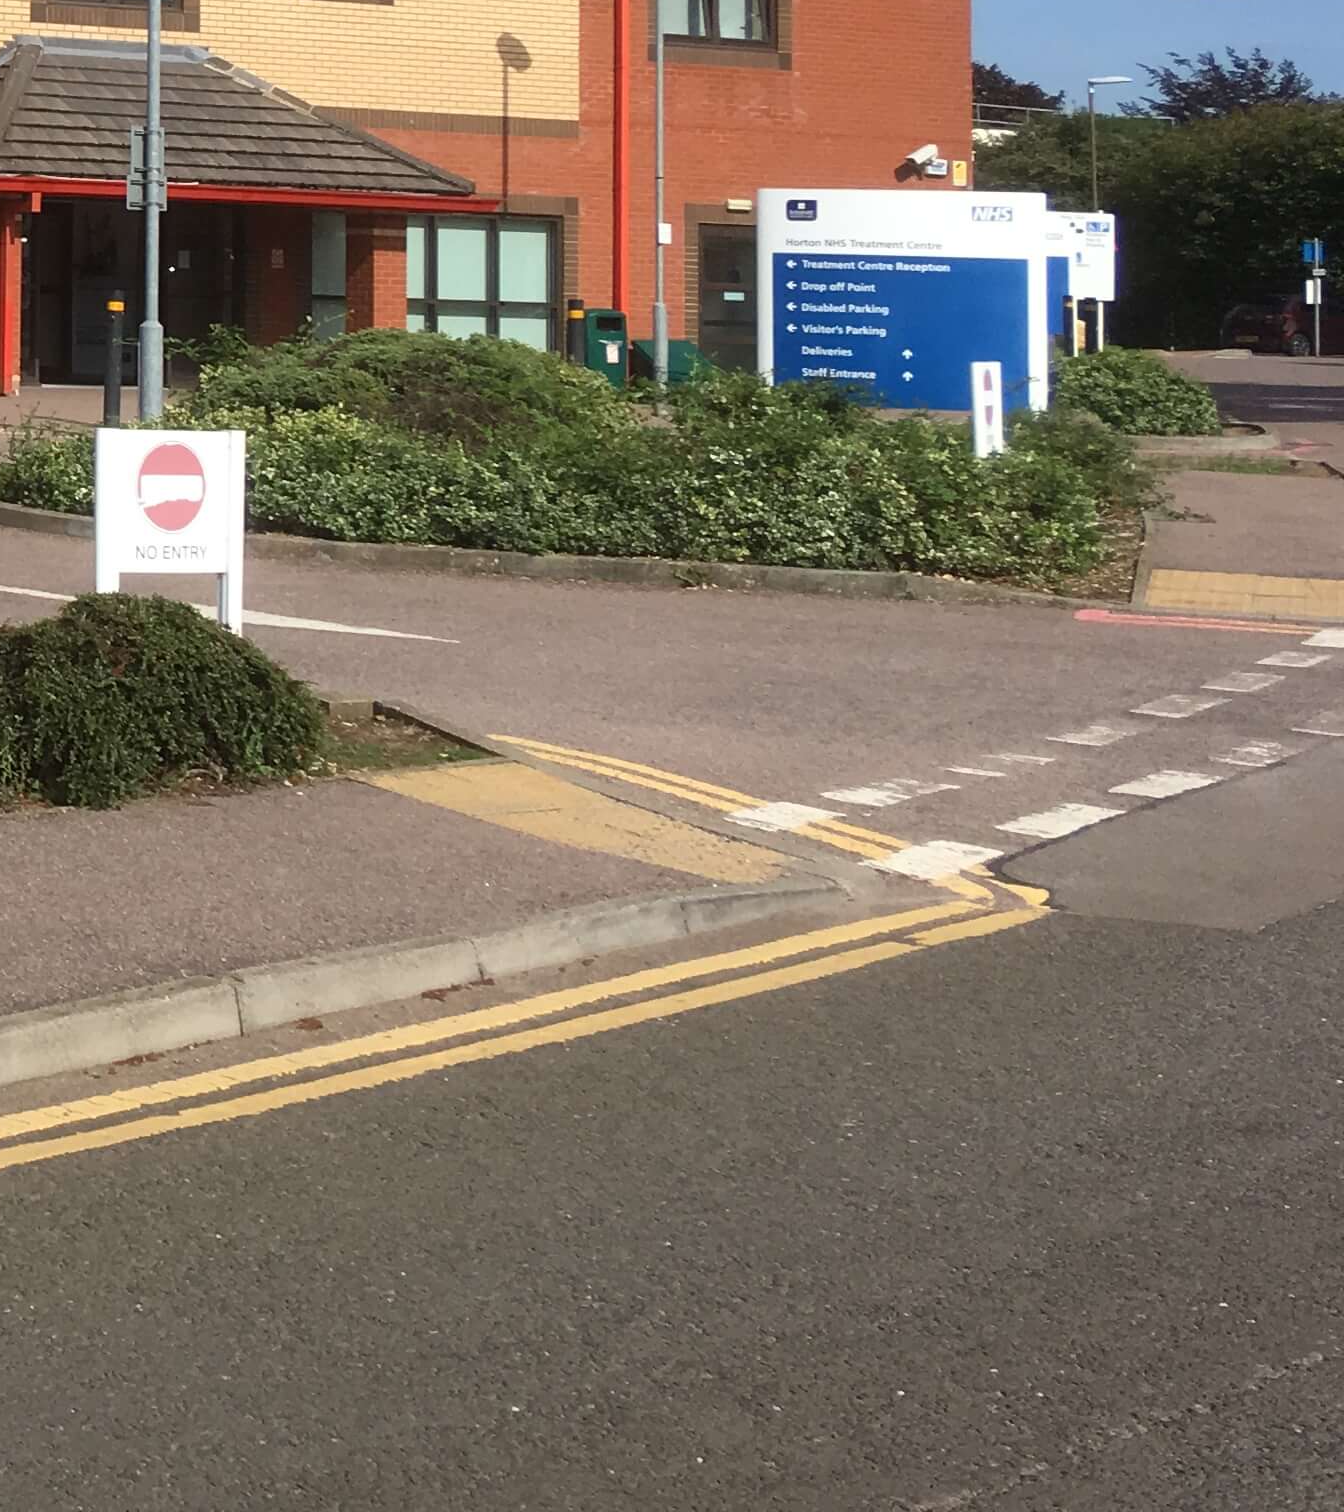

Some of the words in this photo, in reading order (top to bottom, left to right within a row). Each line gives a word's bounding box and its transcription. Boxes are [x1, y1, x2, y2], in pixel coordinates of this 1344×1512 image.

[973, 206, 1013, 222] NHS
[785, 239, 822, 248] Horton
[824, 239, 847, 248] NHS
[851, 240, 904, 249] Treatment
[907, 241, 943, 250] Centre
[801, 259, 856, 270] Treatment
[857, 261, 894, 271] Centre
[895, 262, 951, 273] Reception
[801, 282, 827, 293] Drop
[829, 282, 846, 292] off
[847, 283, 876, 292] Point
[801, 303, 846, 313] Disabled
[848, 304, 890, 316] Parking
[802, 324, 844, 335] Visitor's
[845, 326, 887, 338] Parking
[801, 346, 853, 357] Deliveries
[801, 367, 827, 378] Staff
[830, 368, 877, 379] Entrance
[136, 545, 158, 560] NO
[162, 545, 208, 560] ENTRY
